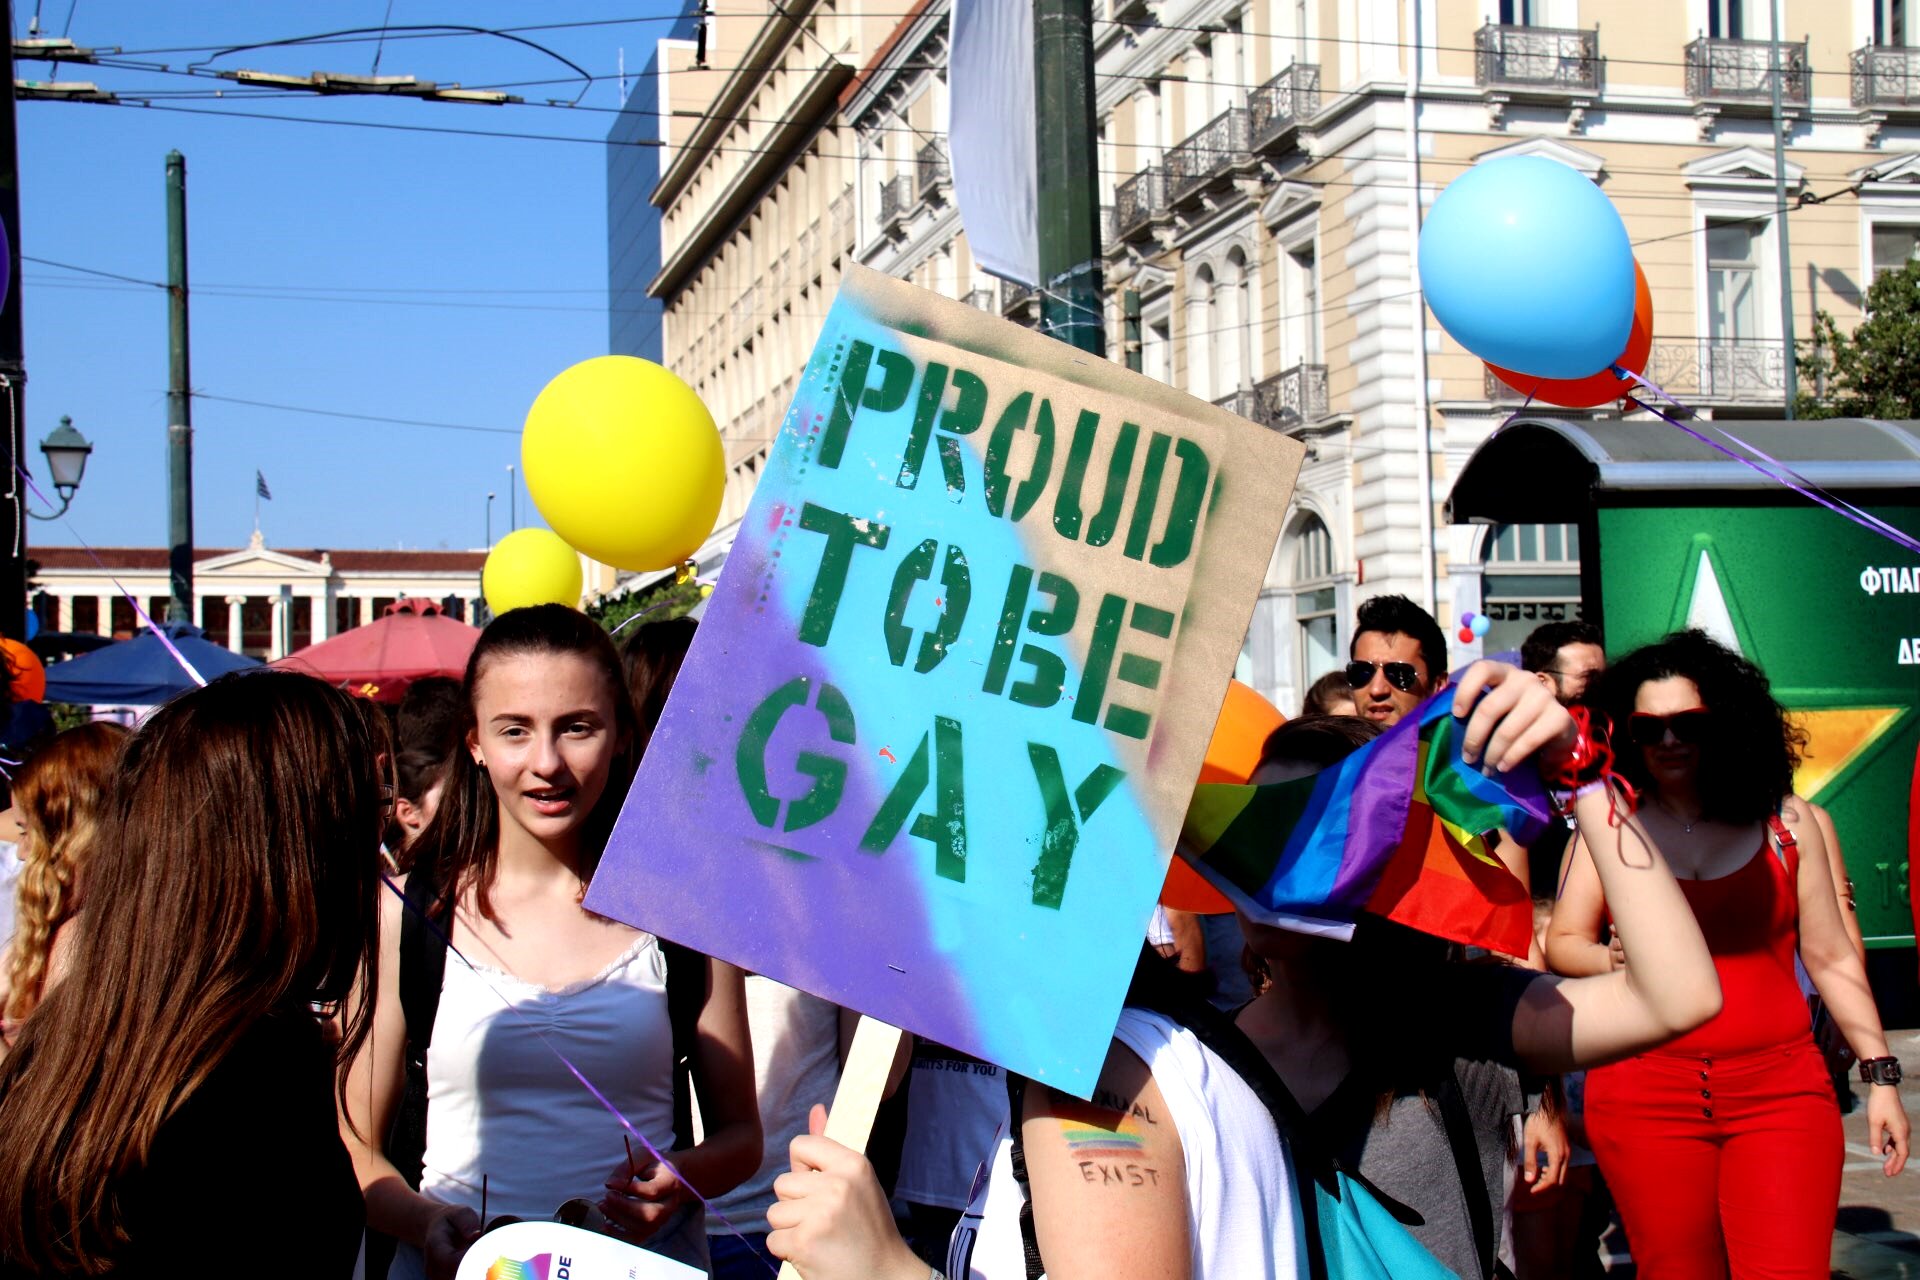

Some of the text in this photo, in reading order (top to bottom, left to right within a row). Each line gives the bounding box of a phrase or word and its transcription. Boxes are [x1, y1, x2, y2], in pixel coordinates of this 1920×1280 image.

[818, 339, 1210, 568] PROUD
[799, 501, 1174, 740] TO BE
[736, 675, 1128, 910] GAY
[946, 1060, 969, 1073] FOR
[973, 1064, 997, 1076] YOU
[1079, 1161, 1159, 1186] EXIST
